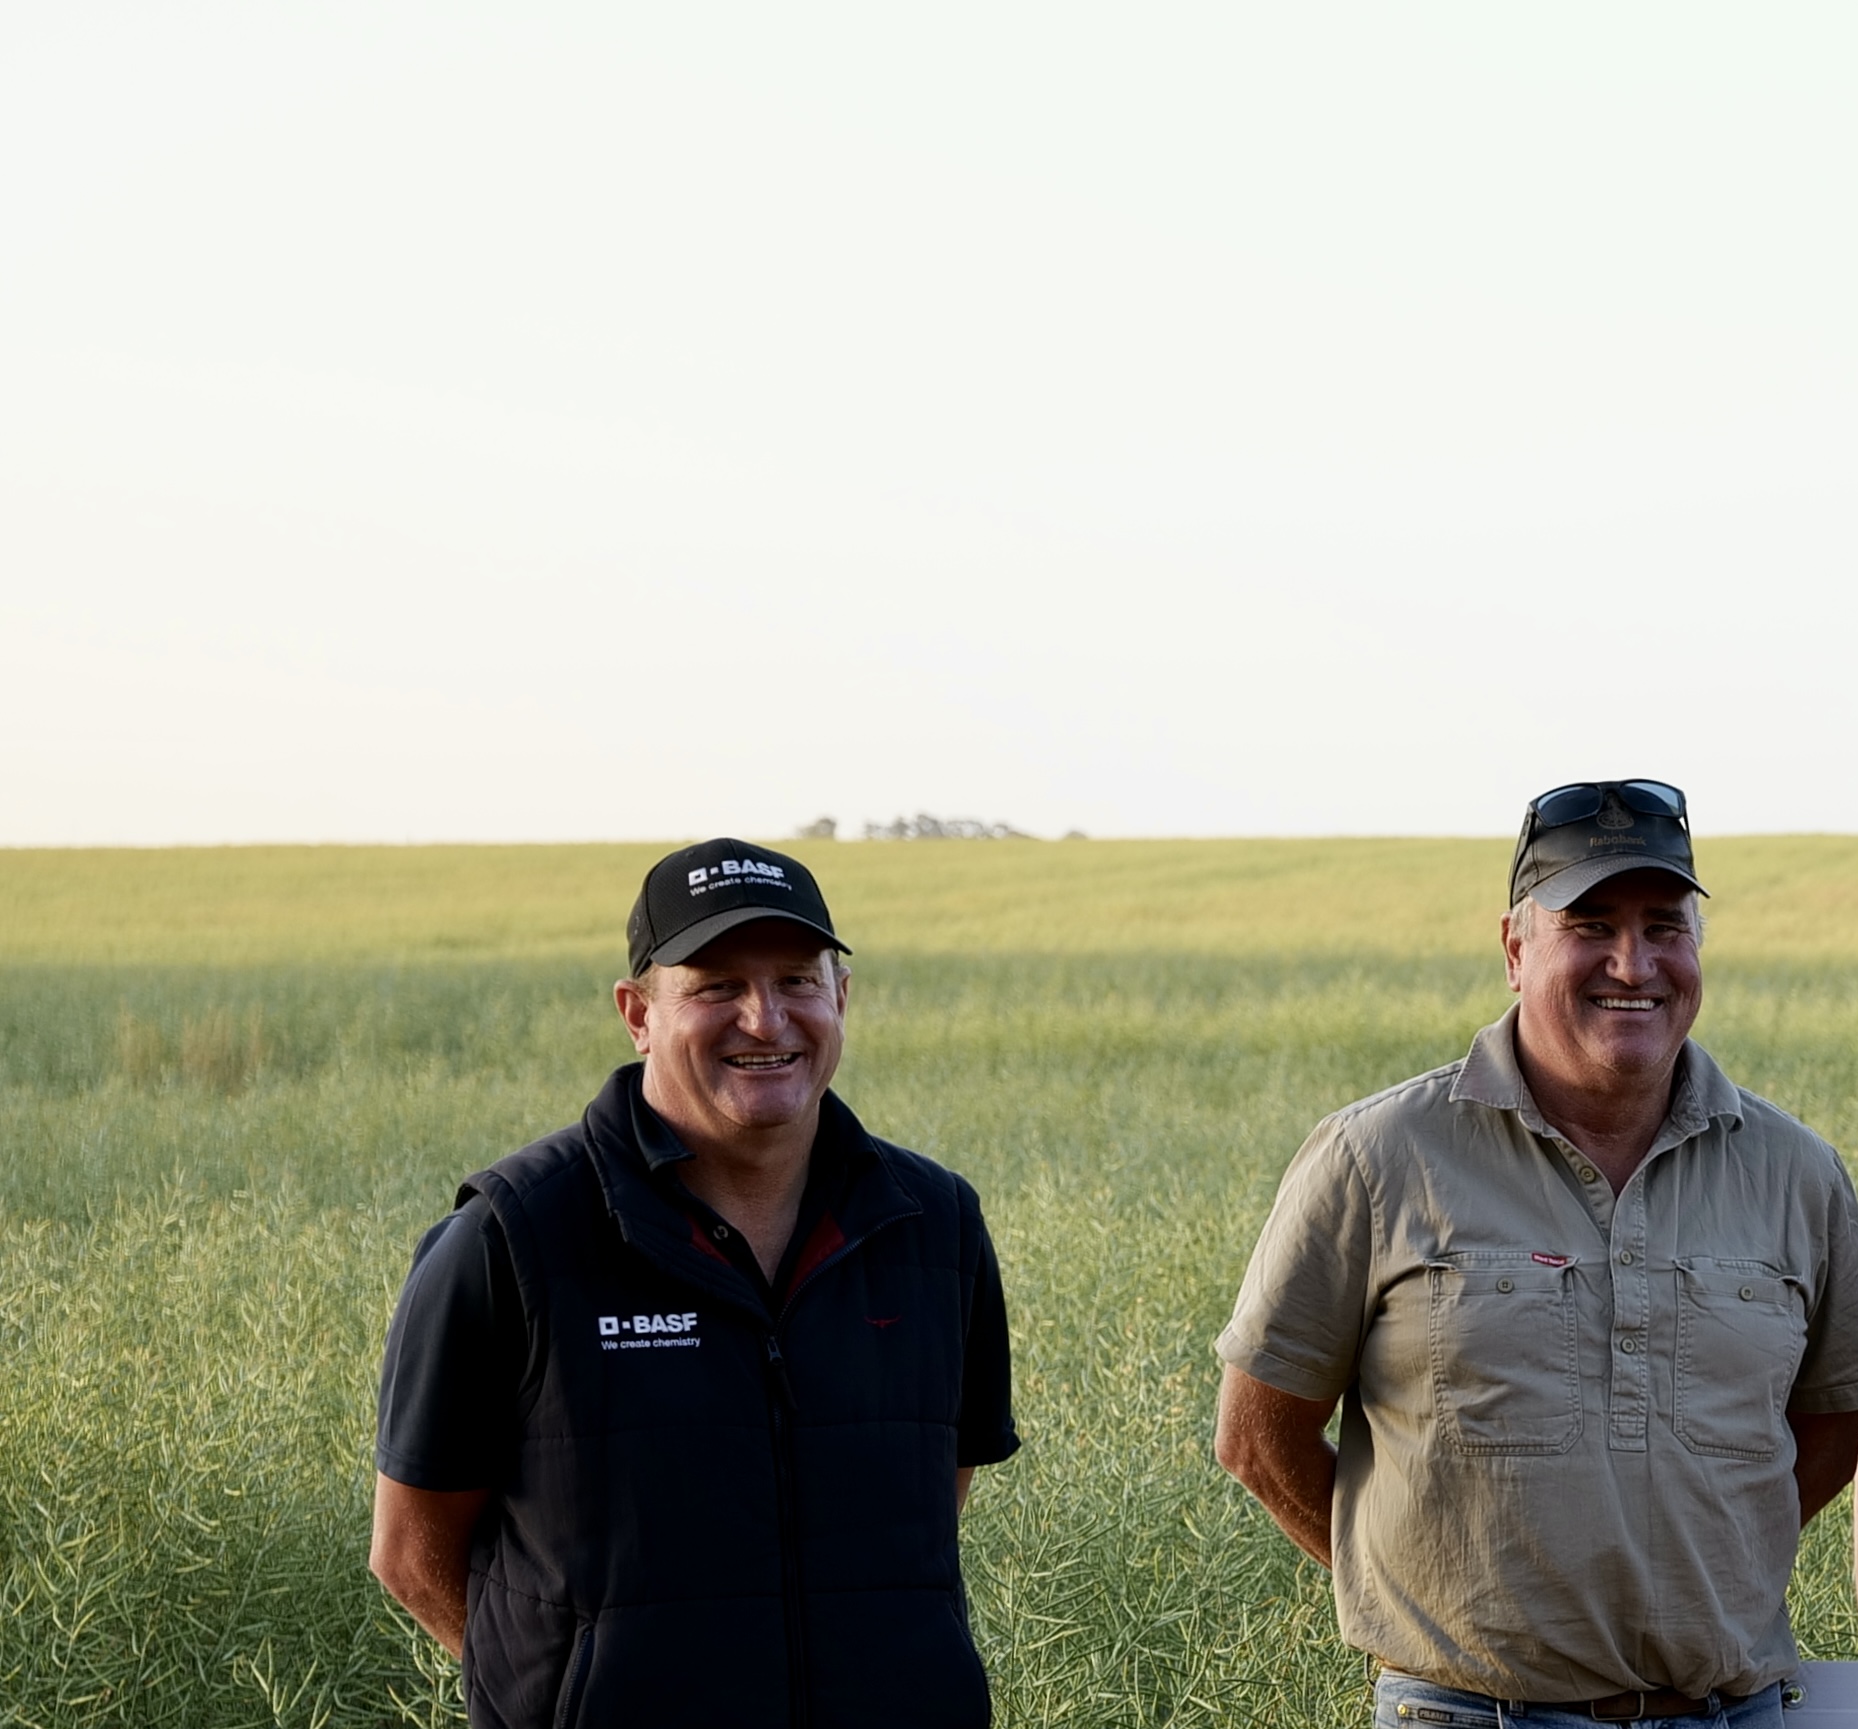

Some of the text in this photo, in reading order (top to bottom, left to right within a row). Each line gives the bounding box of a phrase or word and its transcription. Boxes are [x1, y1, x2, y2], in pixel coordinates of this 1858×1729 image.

[1589, 834, 1647, 848] Rabobank
[721, 859, 785, 879] BASF
[690, 885, 707, 897] We
[708, 877, 742, 891] create
[633, 1312, 698, 1334] BASF
[601, 1337, 701, 1351] We create chemistry
